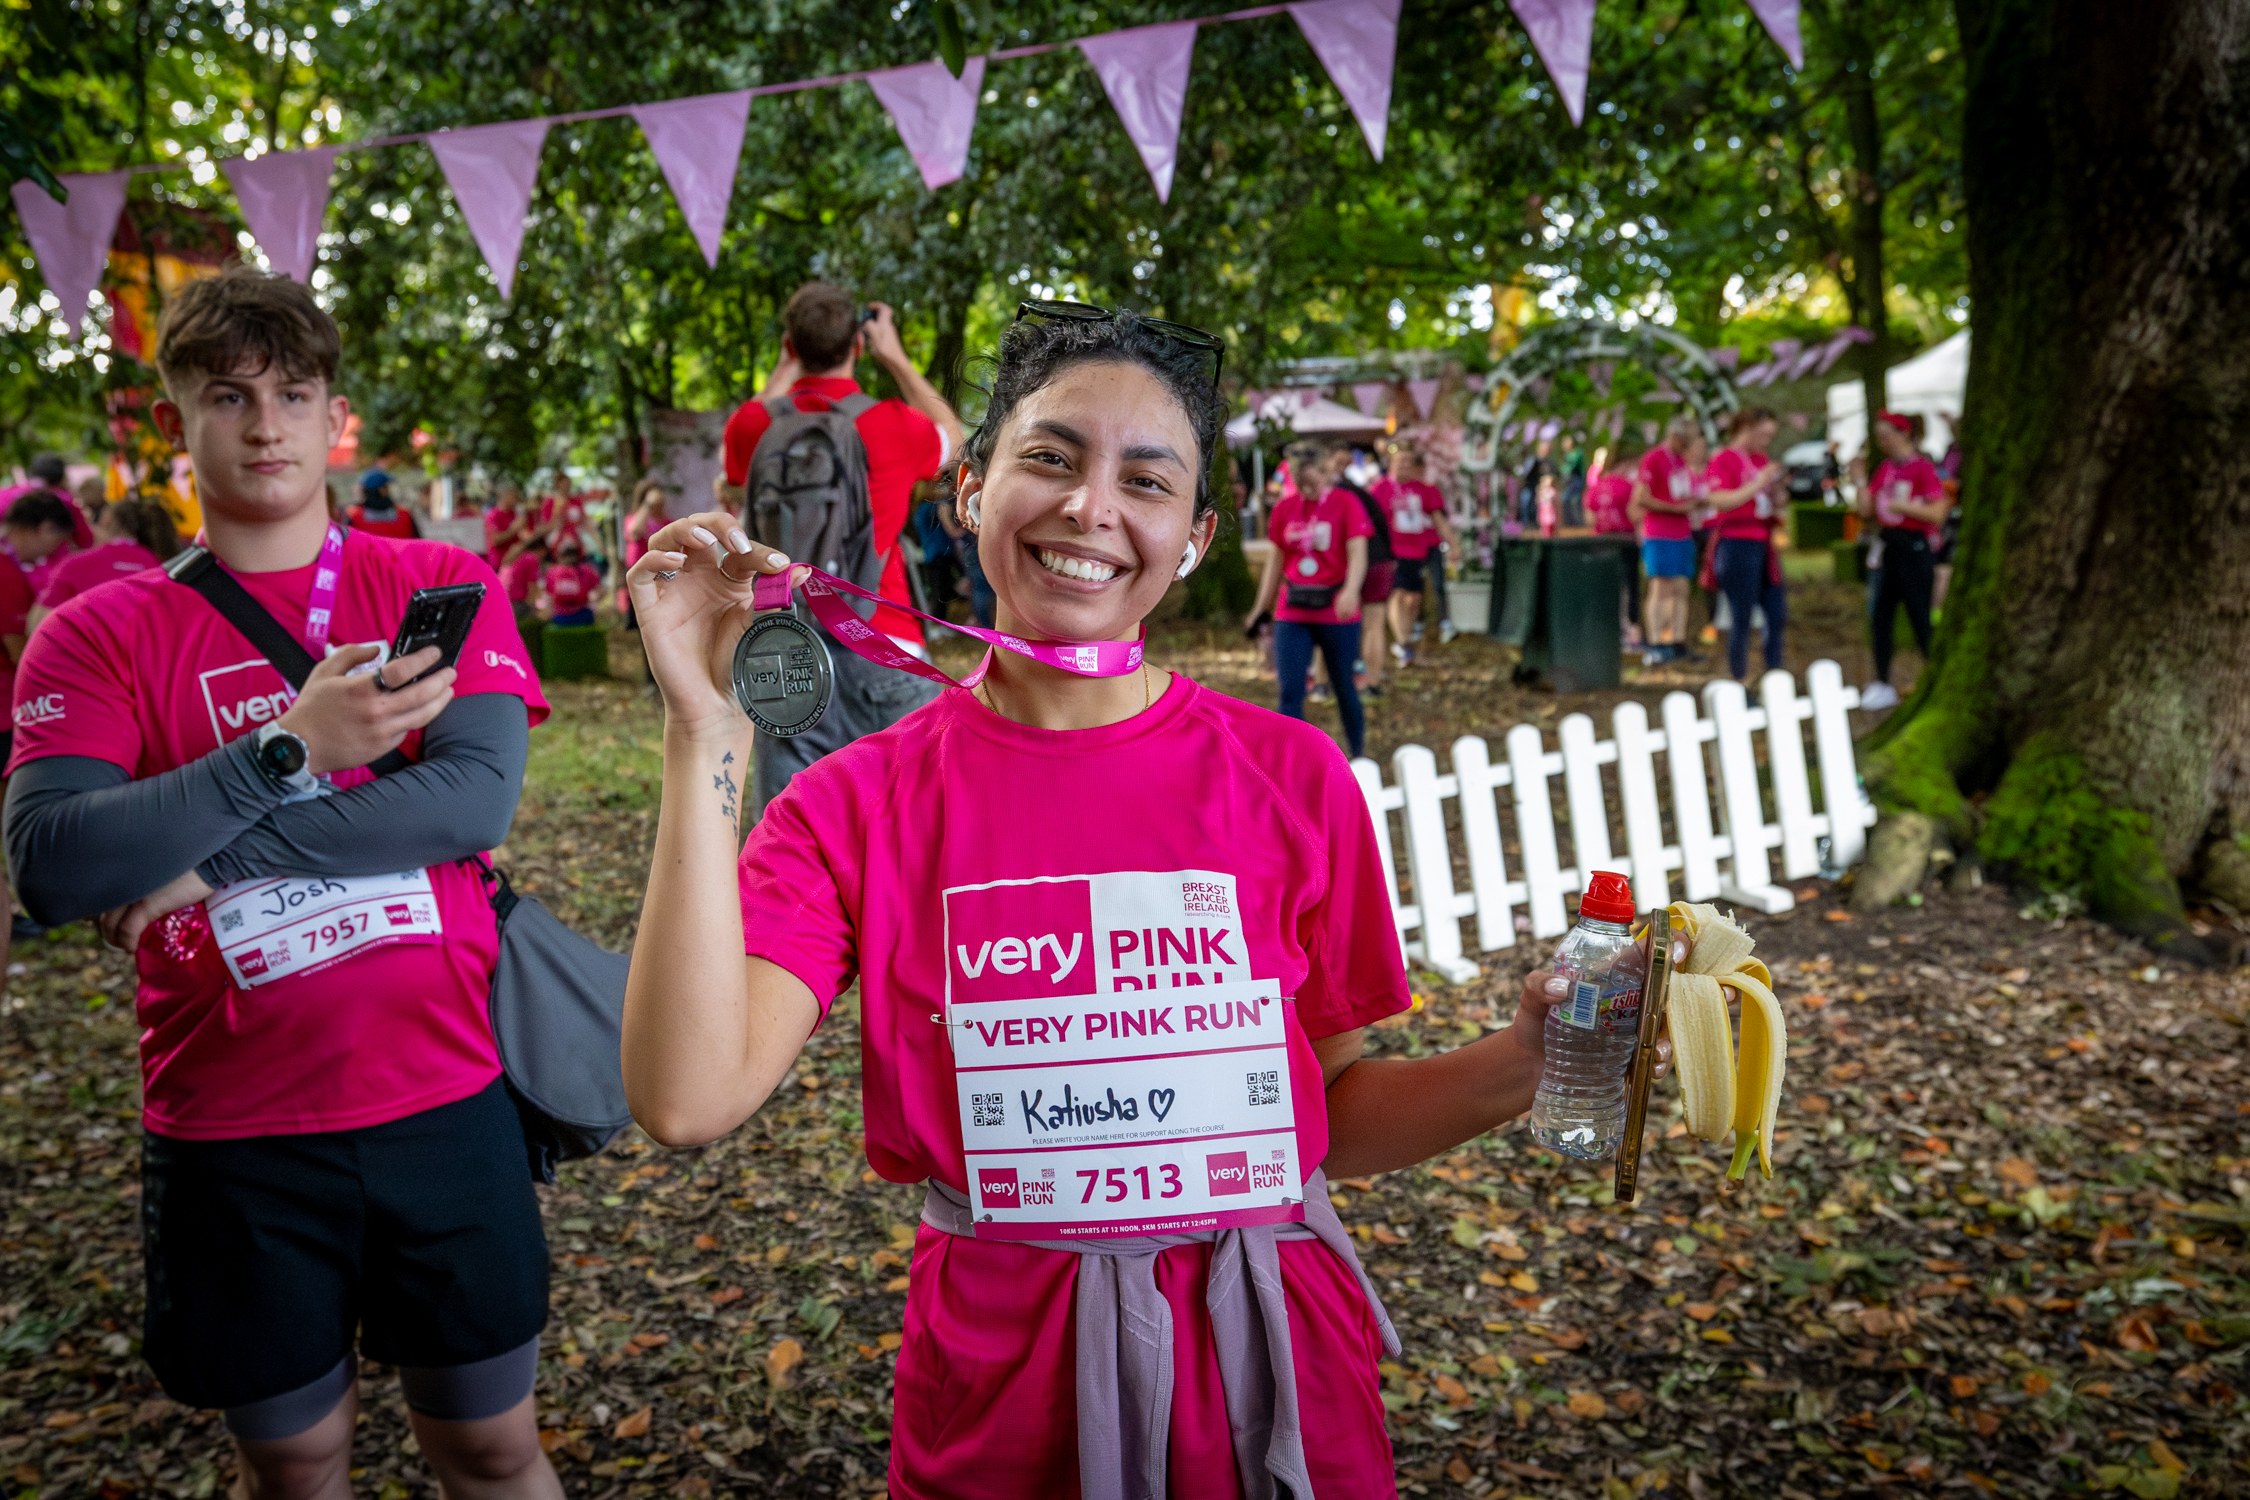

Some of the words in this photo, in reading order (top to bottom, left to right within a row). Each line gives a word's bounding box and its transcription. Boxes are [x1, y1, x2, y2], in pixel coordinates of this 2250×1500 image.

[1078, 655, 1096, 663] PINK
[750, 669, 779, 685] very
[785, 667, 815, 681] PINK
[786, 680, 814, 694] RUN
[219, 690, 293, 729] ver
[749, 711, 772, 731] MADE
[772, 727, 780, 735] A
[782, 700, 827, 735] DIFFERENCE
[260, 877, 347, 915] Josh
[1183, 892, 1229, 906] CANCER
[386, 909, 409, 919] very
[412, 909, 431, 917] PINK
[1184, 902, 1231, 914] IRELAND
[301, 912, 369, 953] 7957
[239, 956, 264, 972] very
[266, 947, 291, 960] PINK
[269, 955, 291, 968] RUN
[957, 932, 1083, 984] very
[1109, 927, 1238, 970] PINK
[976, 1015, 1074, 1048] VERY
[1084, 1007, 1175, 1041] PINK
[1184, 1000, 1262, 1032] RUN
[1021, 1083, 1139, 1134] Katiusha
[1054, 1136, 1073, 1144] WRITE
[1073, 1134, 1090, 1142] YOUR
[1091, 1133, 1109, 1141] NAME
[1109, 1132, 1125, 1140] HERE
[1139, 1129, 1167, 1138] SUPPORT
[1167, 1127, 1189, 1135] ALONG
[1189, 1126, 1201, 1134] THE
[1201, 1124, 1225, 1132] COURSE
[1210, 1166, 1246, 1181] very
[1252, 1162, 1287, 1176] PINK
[982, 1182, 1016, 1196] very
[1022, 1181, 1056, 1193] PINK
[1076, 1163, 1183, 1204] 7513
[1253, 1175, 1284, 1189] RUN
[1023, 1193, 1054, 1205] RUN
[1157, 1222, 1180, 1230] STARTS
[1191, 1218, 1218, 1227] 12:45PM
